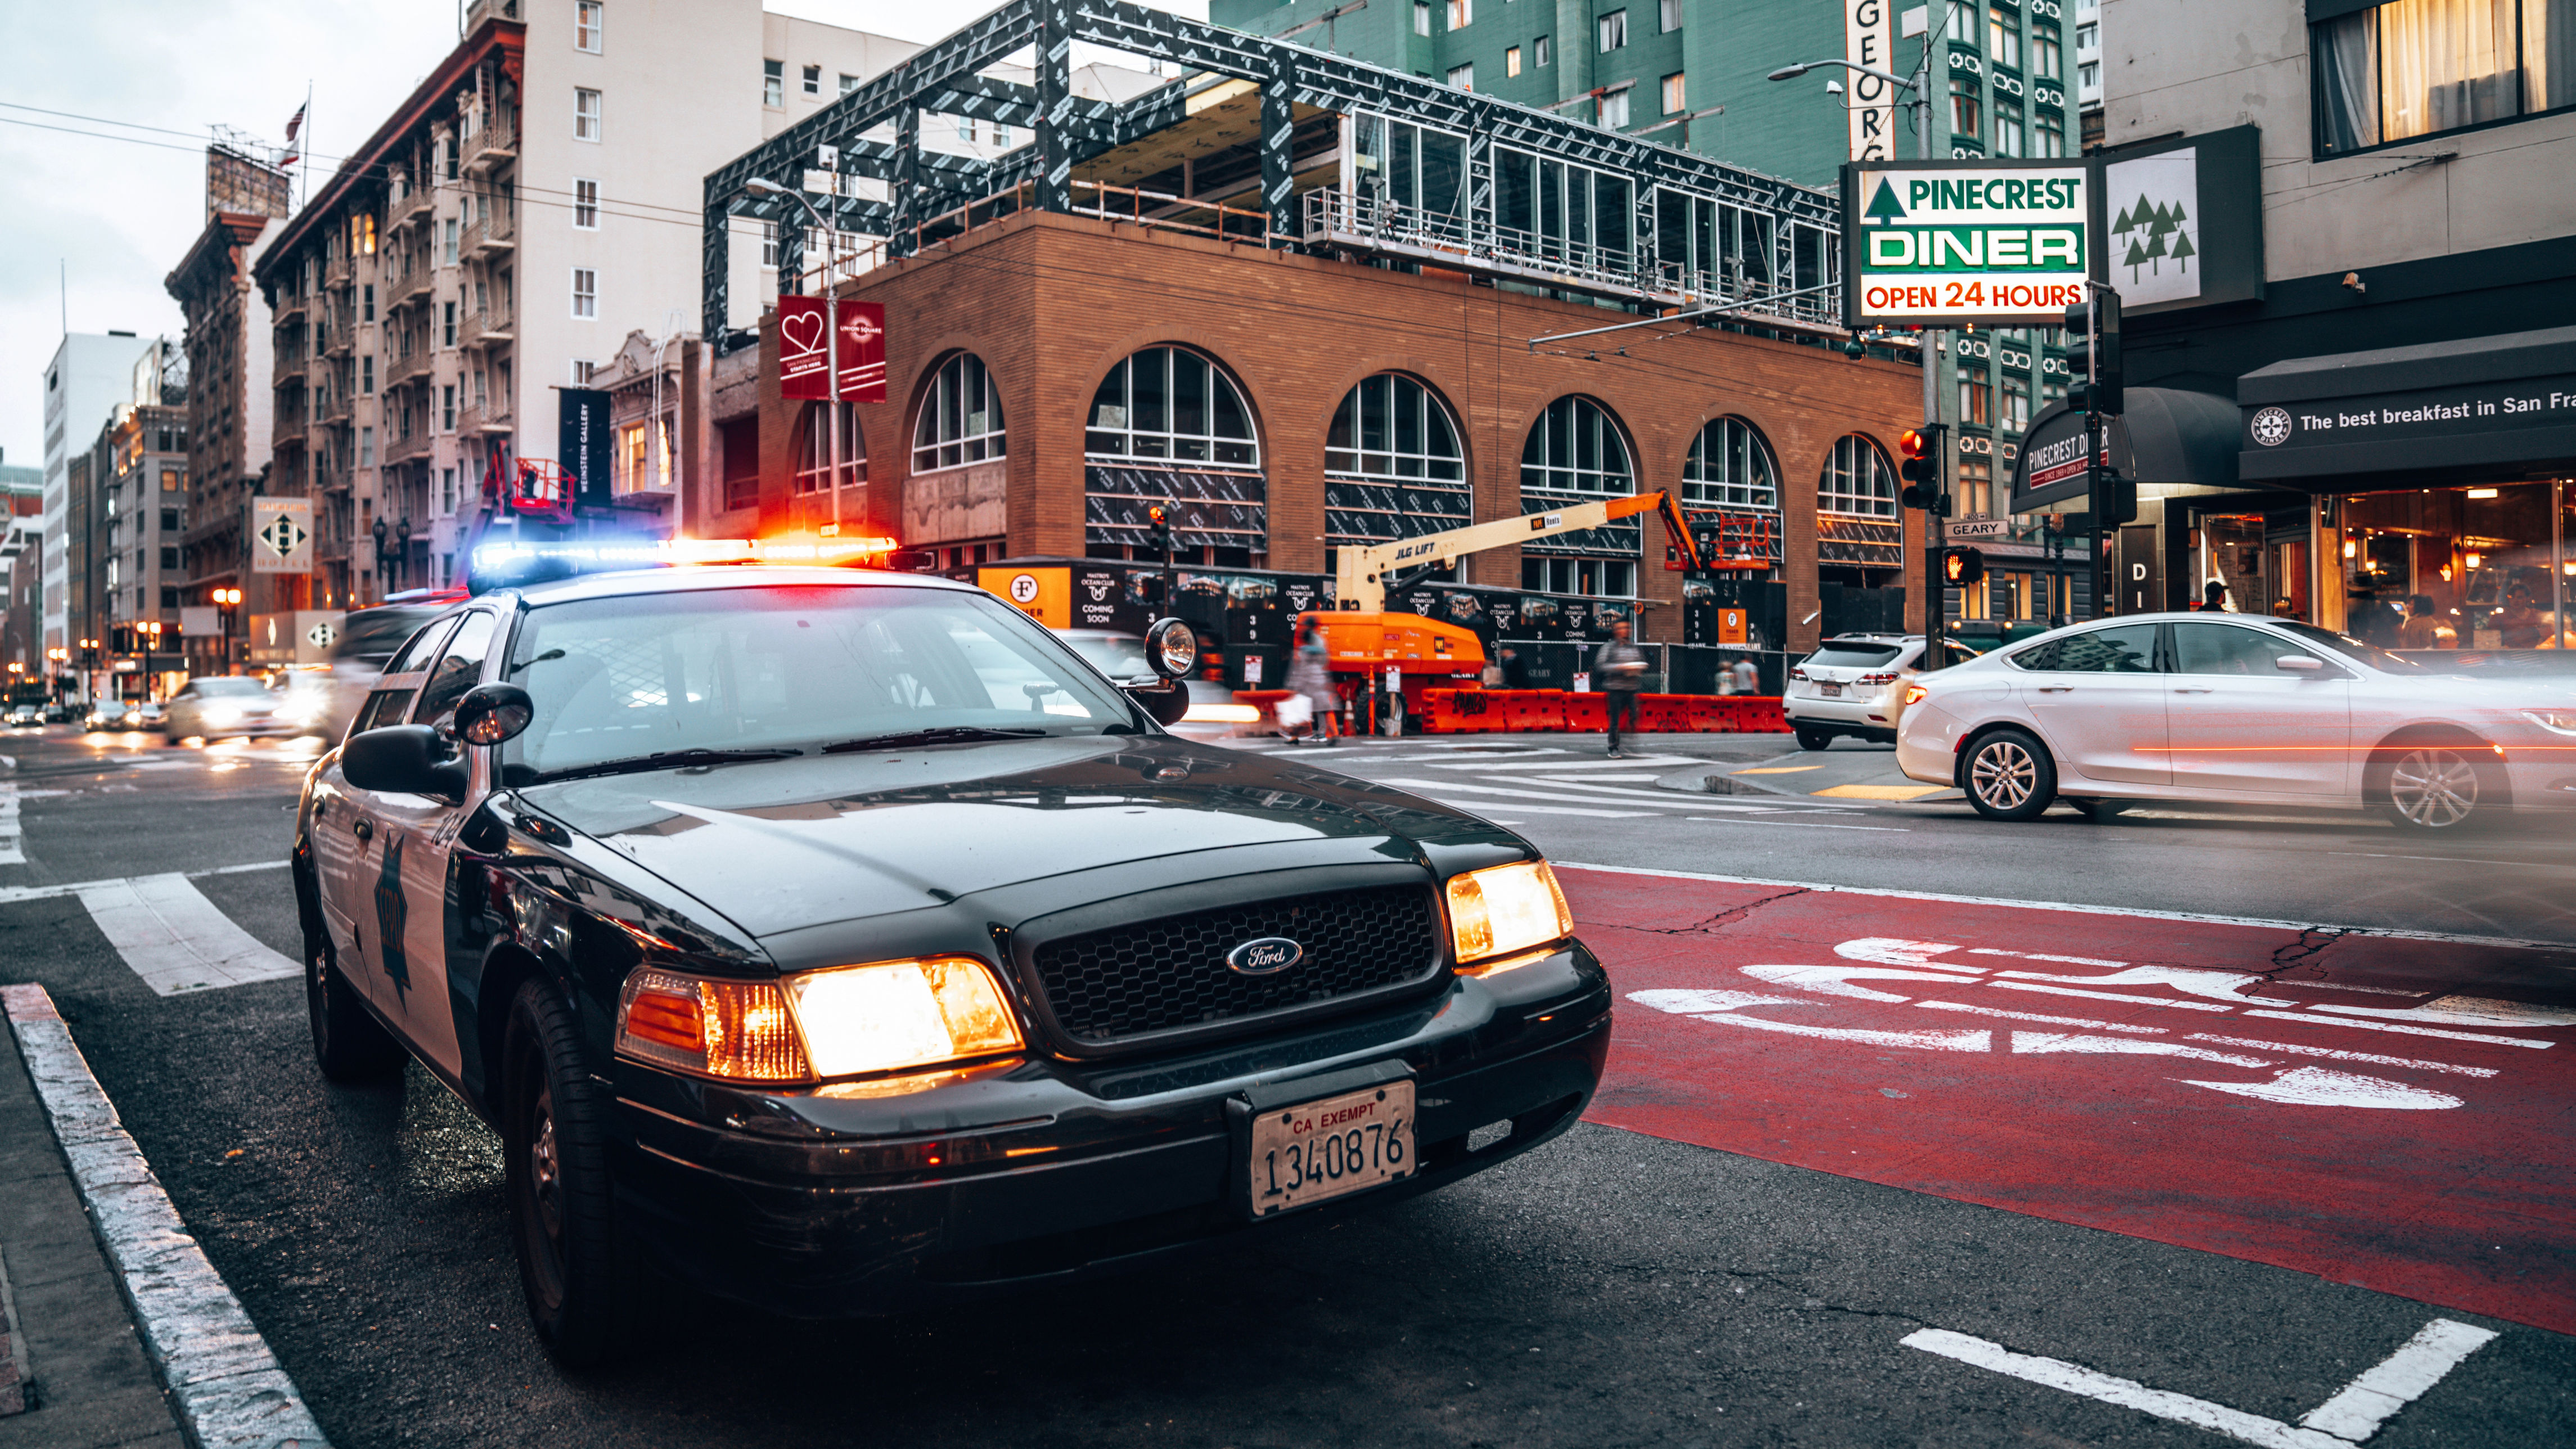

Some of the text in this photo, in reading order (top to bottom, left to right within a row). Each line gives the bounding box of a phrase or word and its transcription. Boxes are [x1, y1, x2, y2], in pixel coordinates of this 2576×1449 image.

[1910, 178, 2080, 210] PINECREST
[1870, 230, 2078, 266] DINER
[1867, 282, 2081, 308] OPEN 24 HOURS
[790, 364, 808, 373] STARTS
[2255, 410, 2288, 426] PINECREST
[2300, 415, 2332, 430] The
[2339, 411, 2376, 428] best
[2383, 403, 2470, 424] breakfast
[2478, 400, 2495, 416] in
[2503, 397, 2541, 413] San
[2260, 434, 2284, 443] DINER
[2029, 425, 2108, 471] PINECREST DIR
[2044, 471, 2055, 481] SINCE
[2067, 465, 2076, 474] OPEN
[1546, 517, 1560, 526] Rents
[1953, 523, 1998, 535] GEARY
[1395, 542, 1435, 560] JLG LIFT
[1016, 581, 1032, 597] F
[1082, 605, 1114, 614] COMING
[1087, 615, 1110, 623] SOON
[1248, 944, 1285, 967] Ford
[1294, 1102, 1375, 1134] CA EXEMPT
[1266, 1119, 1403, 1196] 1340876
